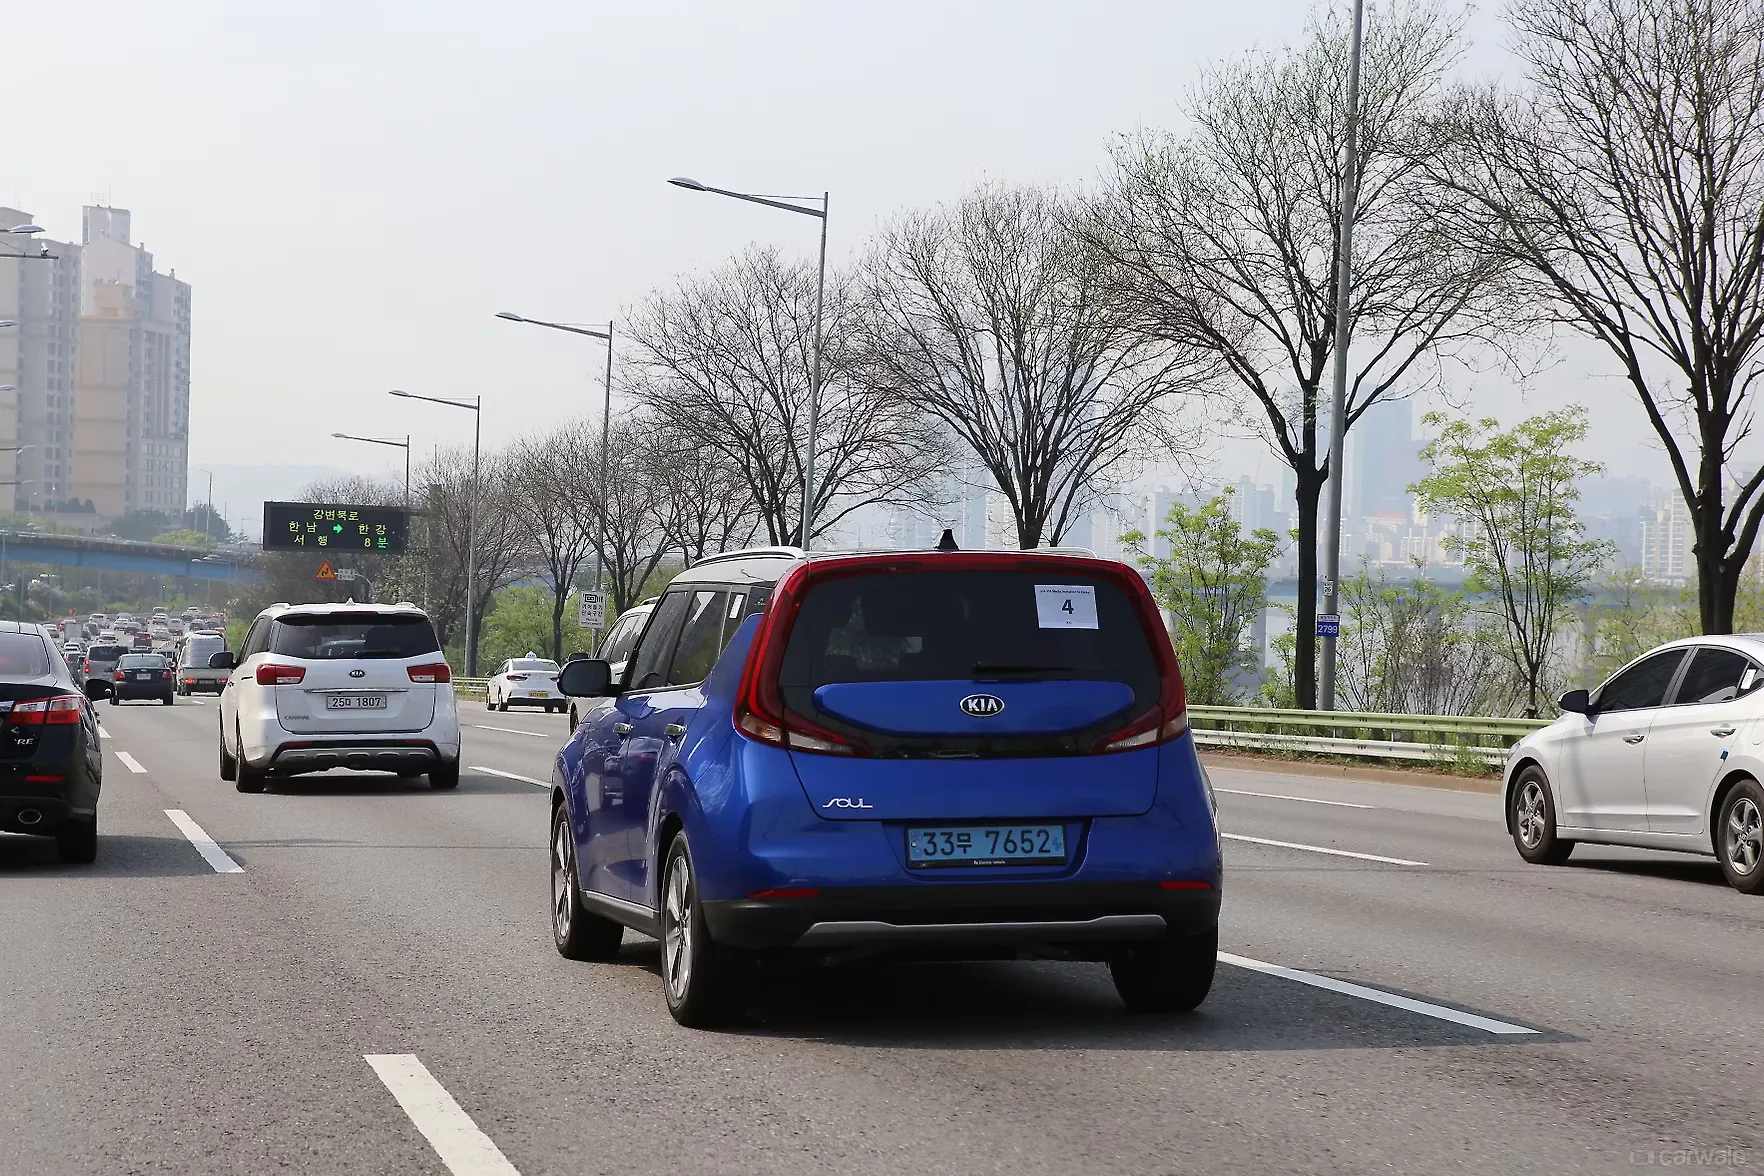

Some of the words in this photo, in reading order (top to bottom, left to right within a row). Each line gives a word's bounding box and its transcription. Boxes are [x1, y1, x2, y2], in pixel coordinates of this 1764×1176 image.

[313, 509, 359, 521] 강변북로
[1061, 599, 1074, 615] 4
[1318, 625, 1338, 634] 2799
[356, 697, 381, 707] 1807
[967, 698, 998, 712] KIA
[822, 797, 873, 809] SOUL
[923, 831, 972, 857] 33무
[985, 828, 1051, 855] 7652
